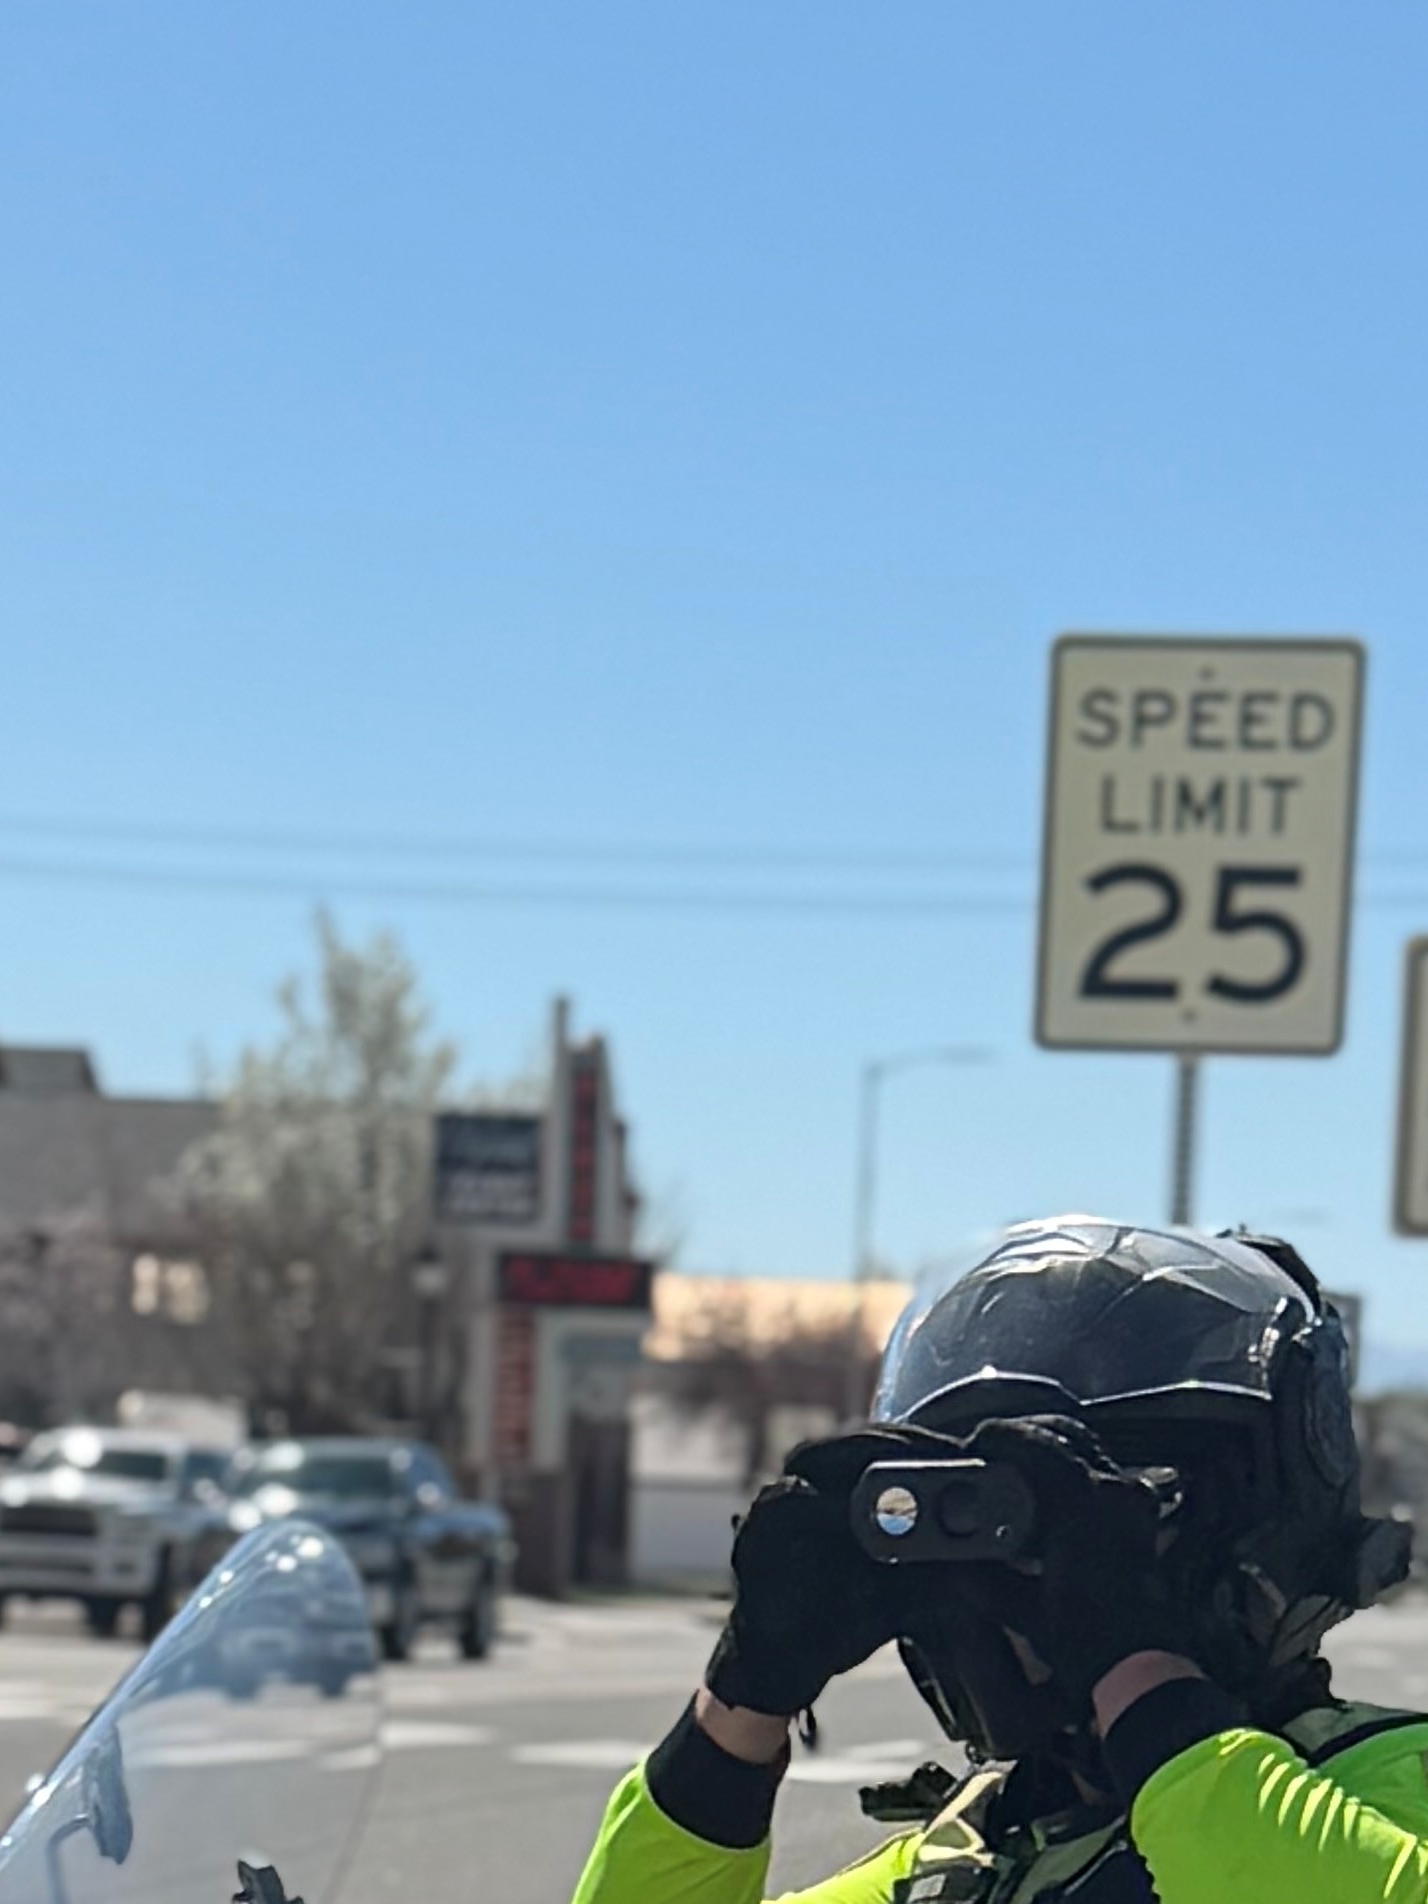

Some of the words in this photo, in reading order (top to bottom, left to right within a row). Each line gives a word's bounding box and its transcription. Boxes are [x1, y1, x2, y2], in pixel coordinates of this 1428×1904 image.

[1076, 687, 1335, 750] SPEED
[1100, 775, 1302, 836] LIMIT
[1080, 861, 1307, 1007] 25
